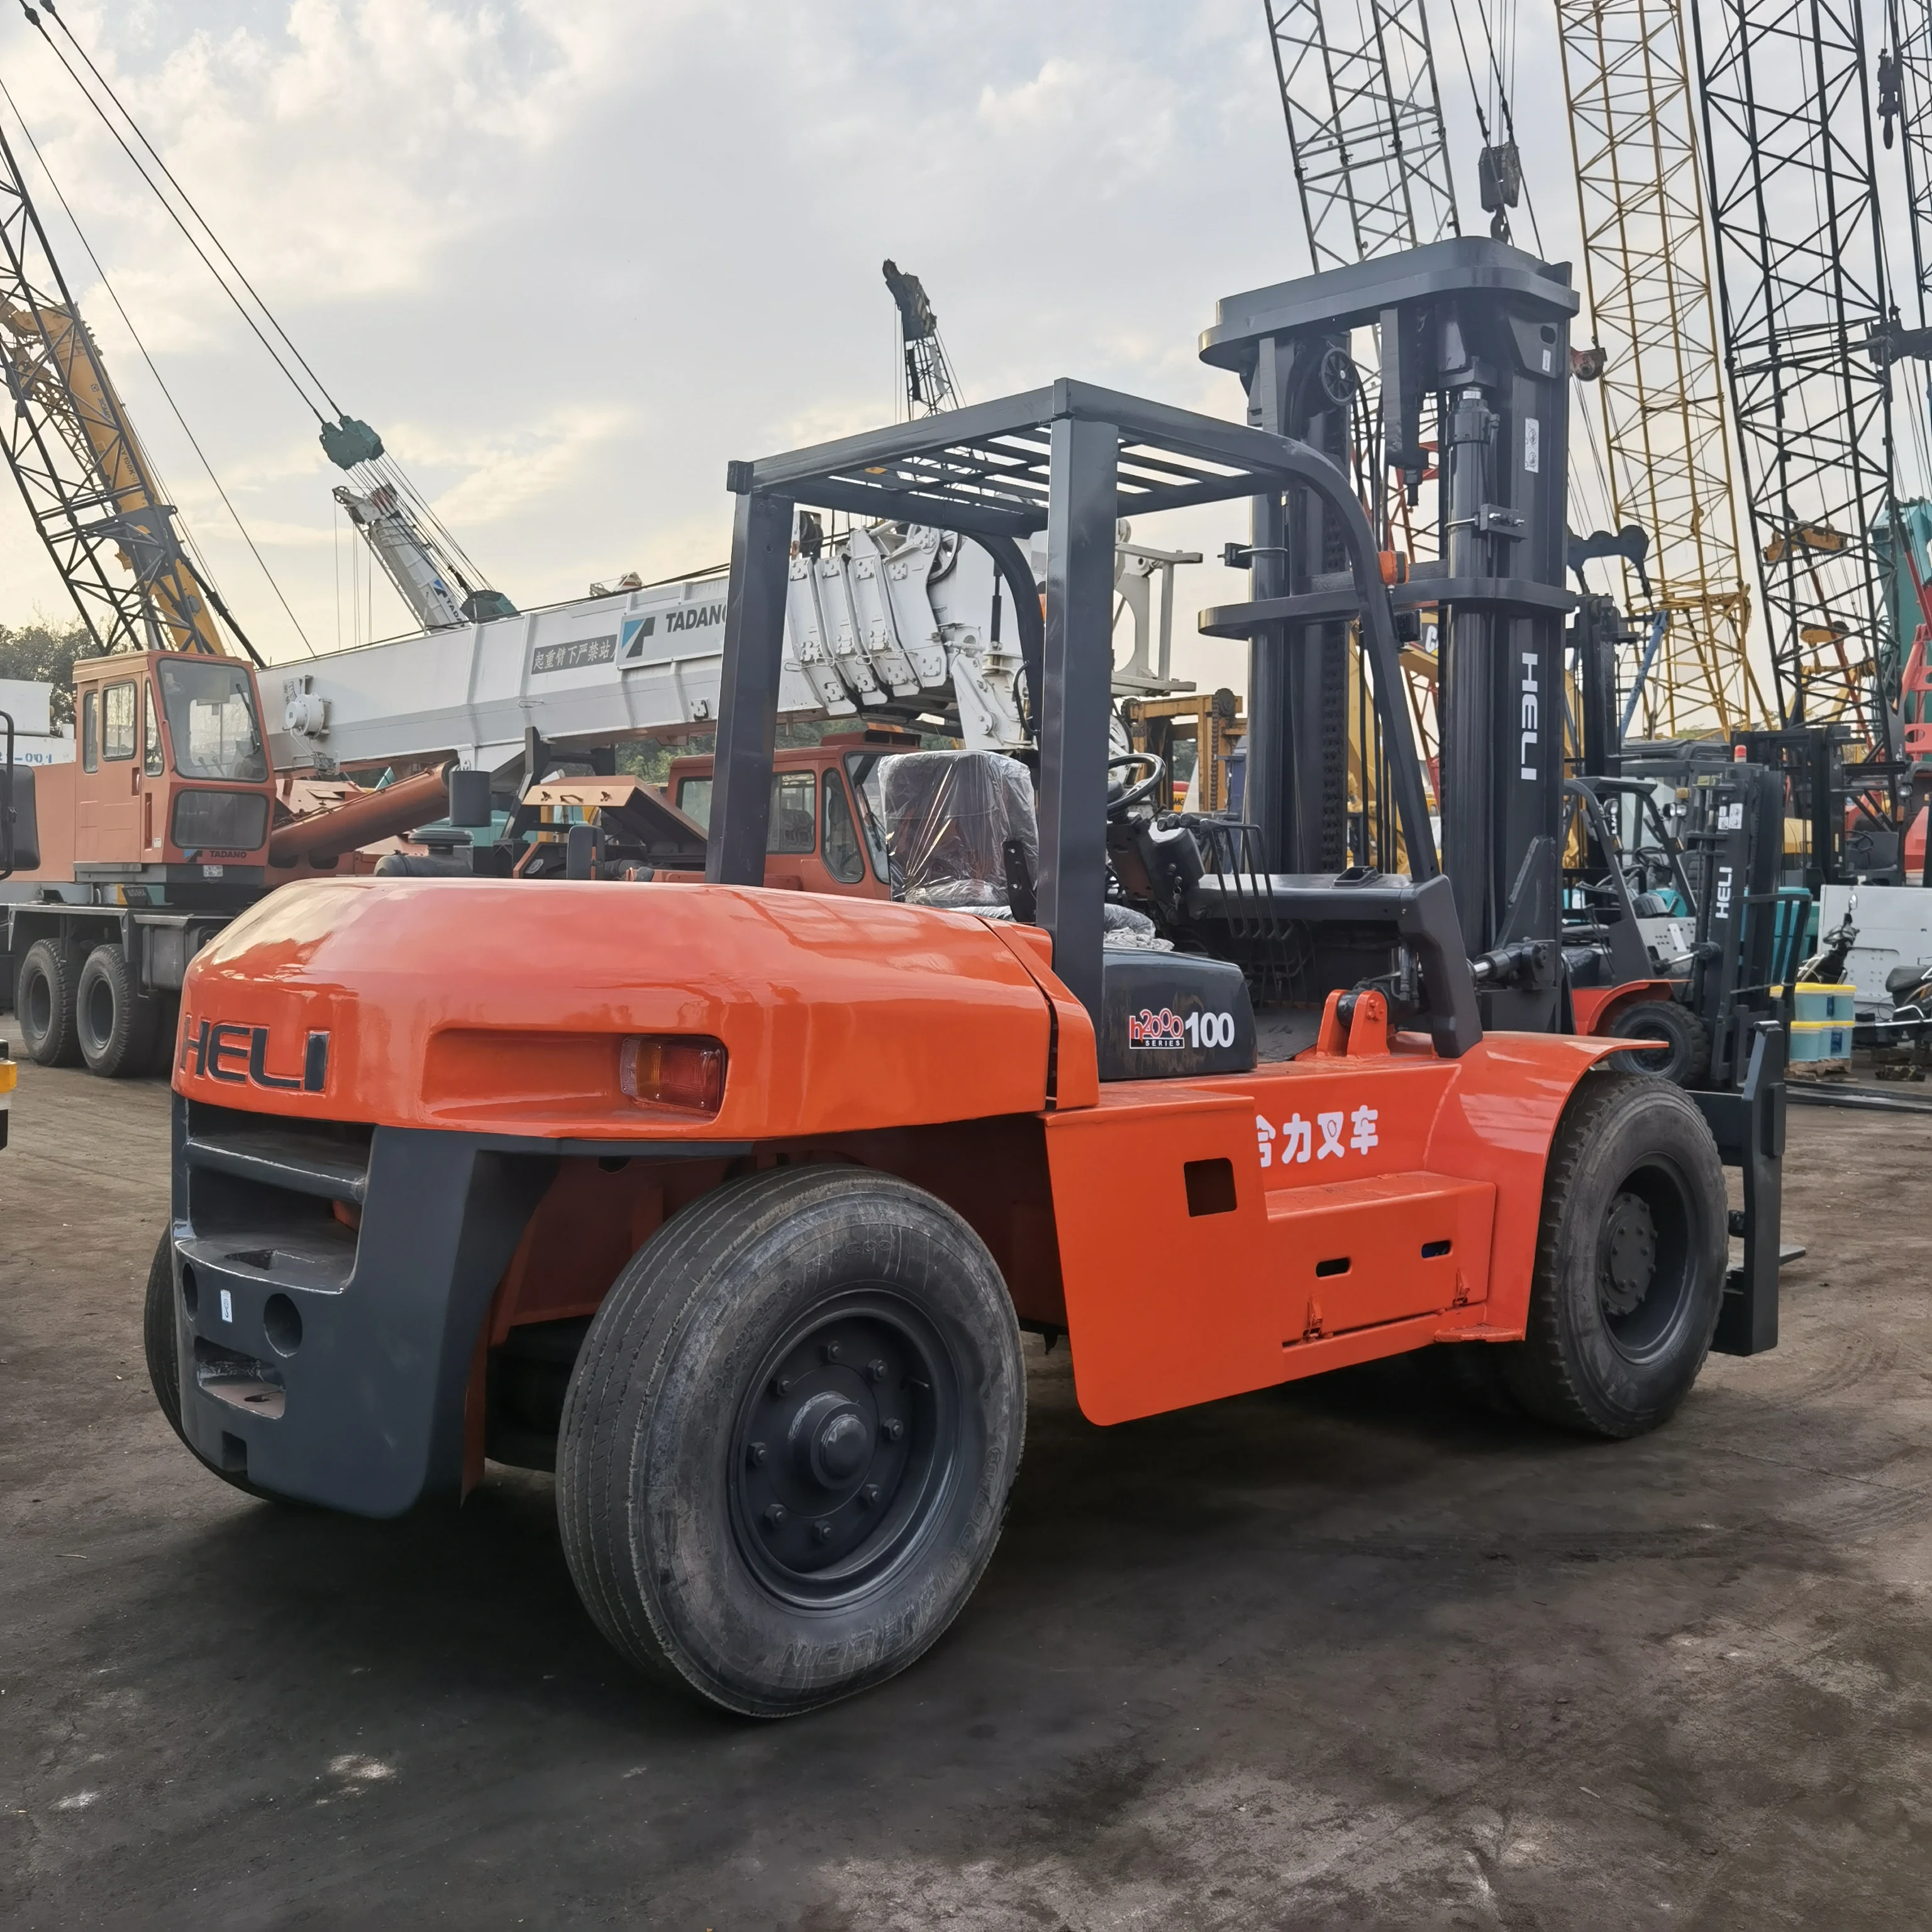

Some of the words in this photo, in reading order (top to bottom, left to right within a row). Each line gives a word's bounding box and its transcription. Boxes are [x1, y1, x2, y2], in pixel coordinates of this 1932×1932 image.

[666, 604, 726, 633] TADAN
[1521, 652, 1538, 780] HELI
[209, 850, 247, 858] TADANO
[1715, 867, 1733, 919] HELI
[1185, 1012, 1235, 1048] 100
[180, 1014, 328, 1092] HELI
